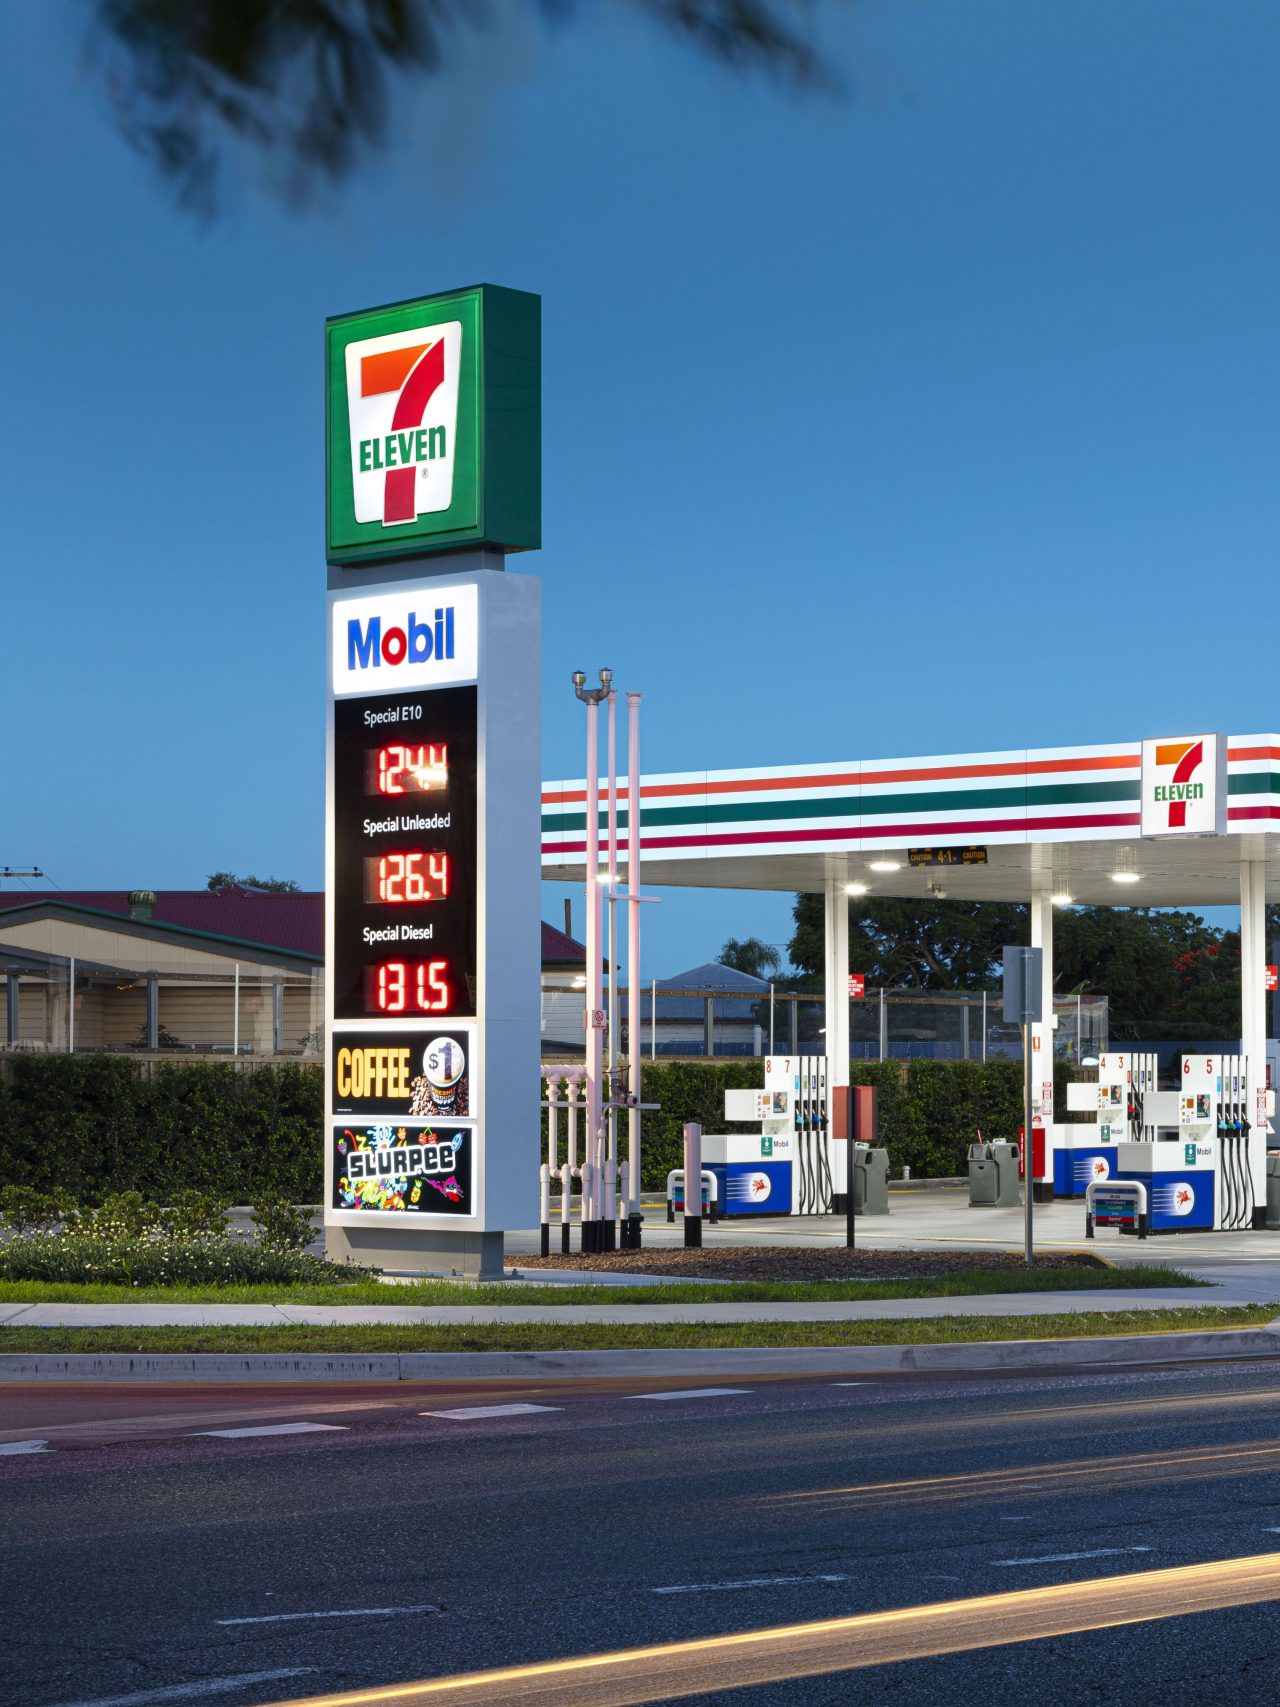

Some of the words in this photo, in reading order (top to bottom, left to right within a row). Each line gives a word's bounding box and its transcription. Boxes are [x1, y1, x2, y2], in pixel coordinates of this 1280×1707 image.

[361, 336, 445, 523] 7
[348, 607, 455, 670] Mobil
[364, 706, 400, 728] Special
[402, 705, 422, 721] E10
[380, 746, 447, 793] 124.4
[1156, 740, 1203, 827] 7
[363, 816, 399, 837] Special
[401, 812, 450, 831] Unleaded
[963, 851, 985, 859] CAUTION
[380, 854, 447, 901] 126.4
[363, 925, 399, 945] Special
[401, 923, 433, 940] Diesel
[379, 962, 448, 1010] 131.5
[337, 1047, 411, 1098] COFFEE
[766, 1060, 772, 1073] 8
[785, 1060, 790, 1073] 7
[1101, 1056, 1106, 1069] 4
[1119, 1056, 1124, 1069] 3
[1183, 1059, 1190, 1074] 6
[1206, 1059, 1213, 1074] 5
[773, 1140, 789, 1148] Mobil
[1197, 1147, 1212, 1155] Mobil
